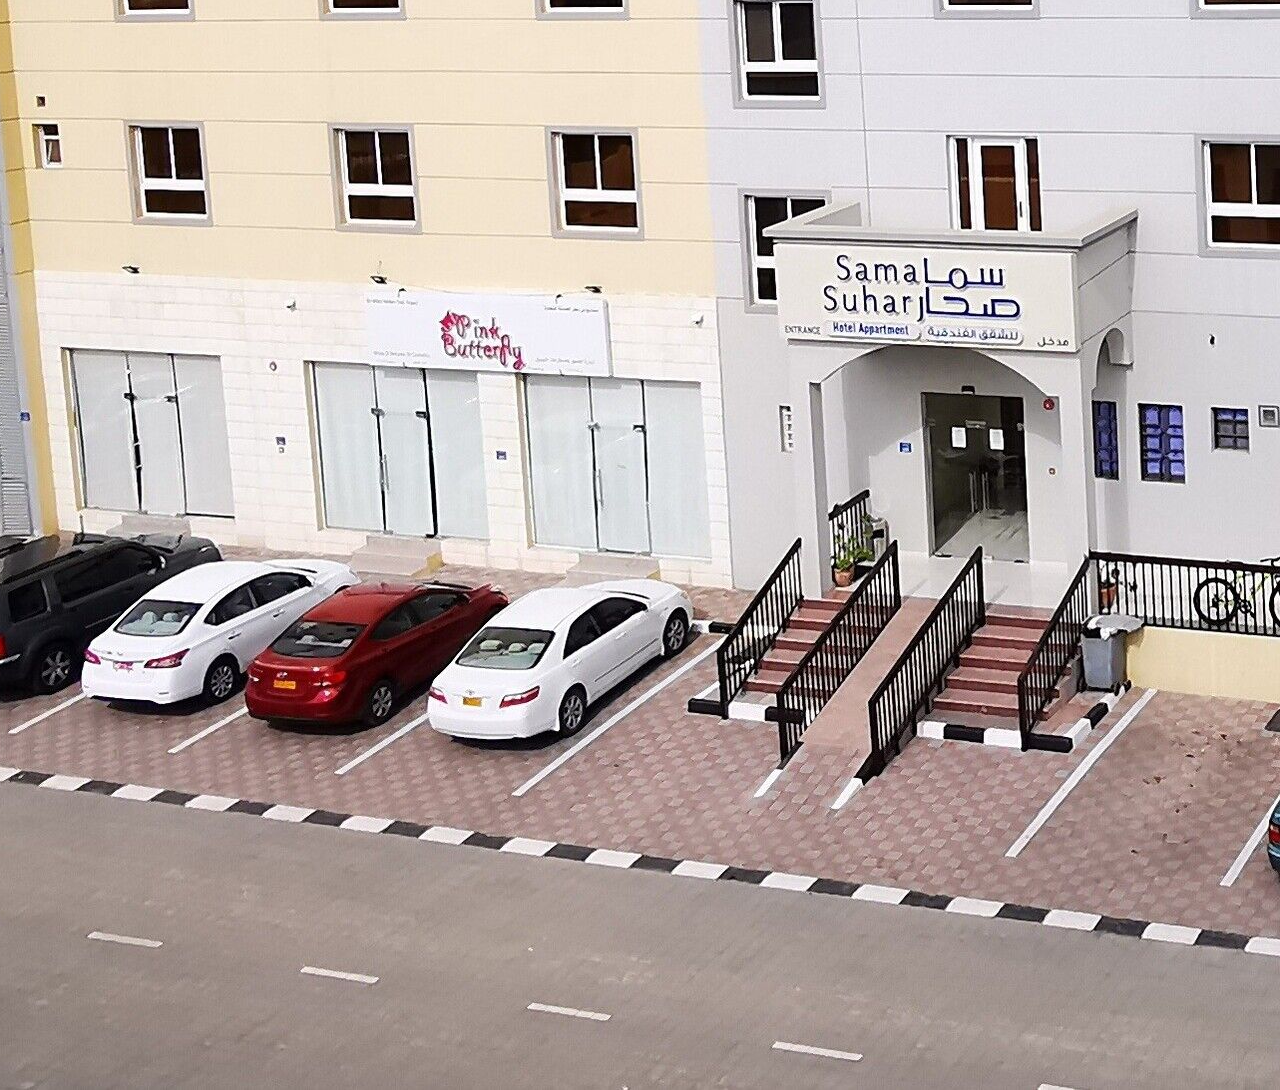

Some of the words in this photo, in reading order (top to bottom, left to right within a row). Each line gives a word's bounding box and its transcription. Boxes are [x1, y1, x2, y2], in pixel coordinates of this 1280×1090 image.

[836, 254, 916, 284] Sama
[923, 257, 1005, 290] سما
[823, 285, 916, 314] Suhar
[917, 286, 1021, 321] صحار
[452, 312, 501, 339] Pink
[784, 324, 822, 336] ENTRANCE
[832, 321, 857, 335] Hotel
[858, 323, 910, 336] Appartment
[441, 334, 526, 370] Butterfly
[1037, 335, 1070, 347] مدخل
